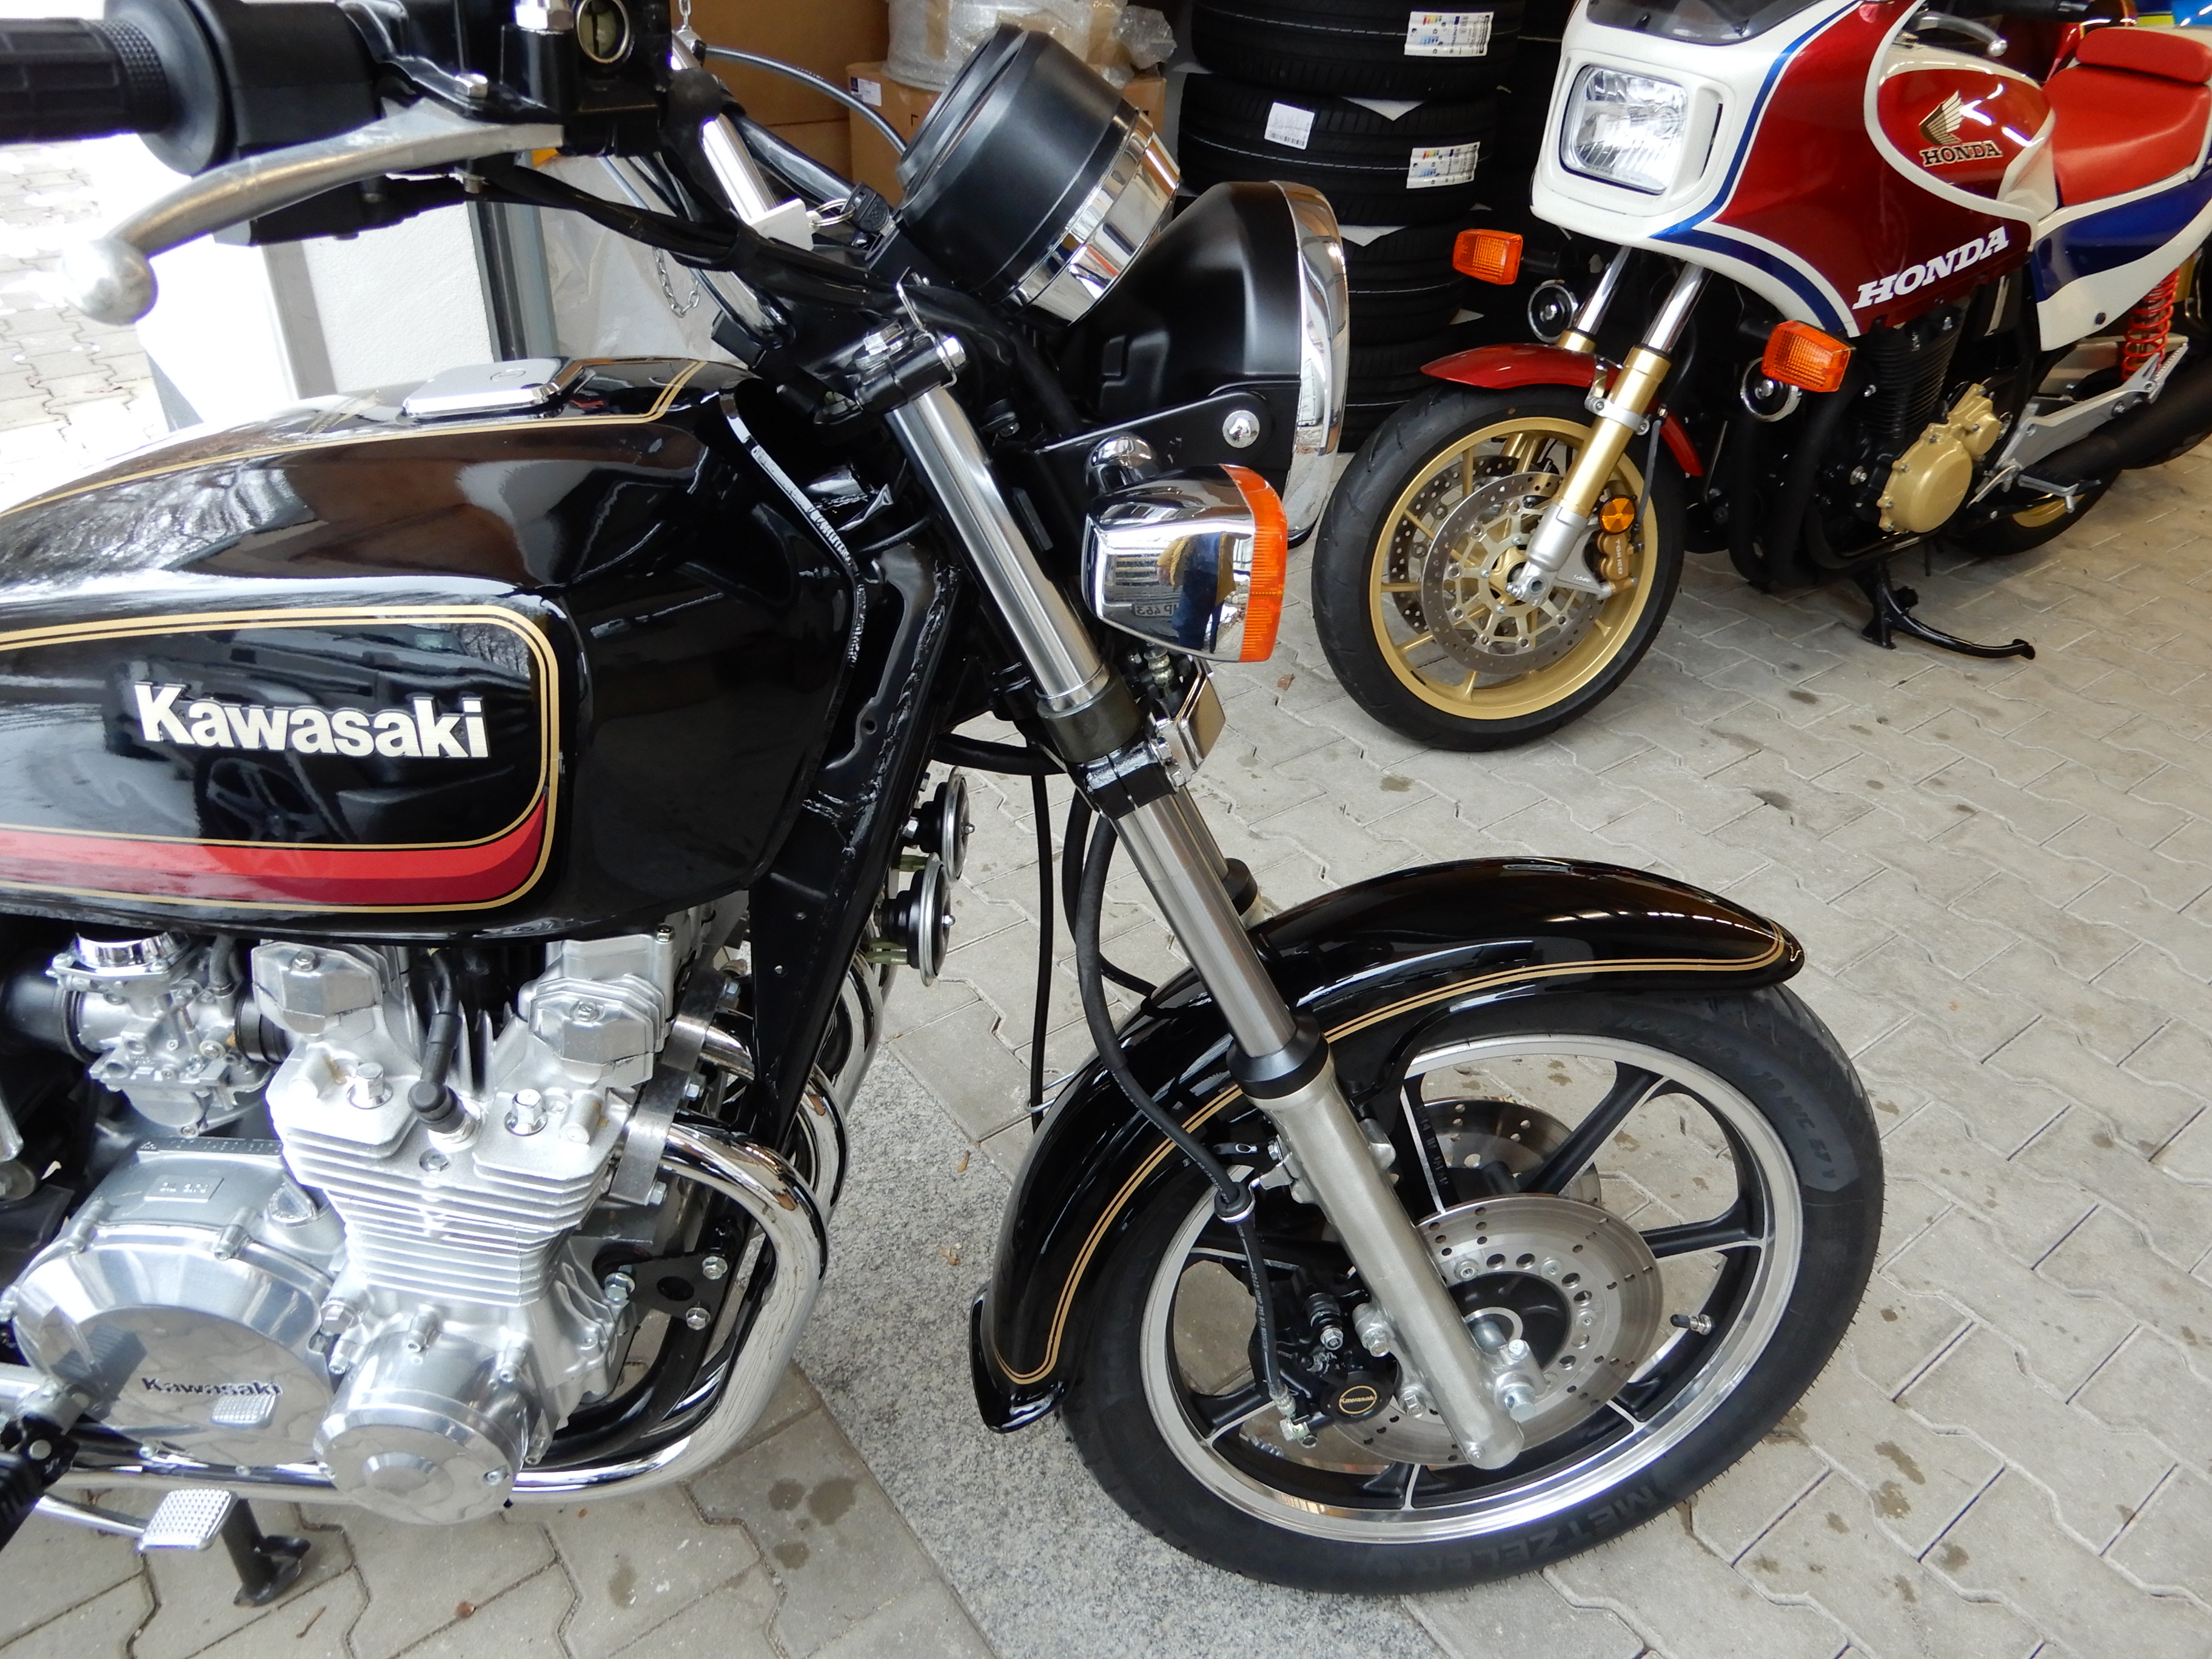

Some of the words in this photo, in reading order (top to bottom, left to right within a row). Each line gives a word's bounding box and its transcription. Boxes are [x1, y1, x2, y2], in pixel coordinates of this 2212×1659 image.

[1920, 140, 2003, 167] HONDA
[1852, 226, 2009, 310] HONDA
[133, 682, 489, 759] Kawasaki
[142, 1377, 283, 1395] Kawasaki
[1419, 1485, 1656, 1572] METZELER
